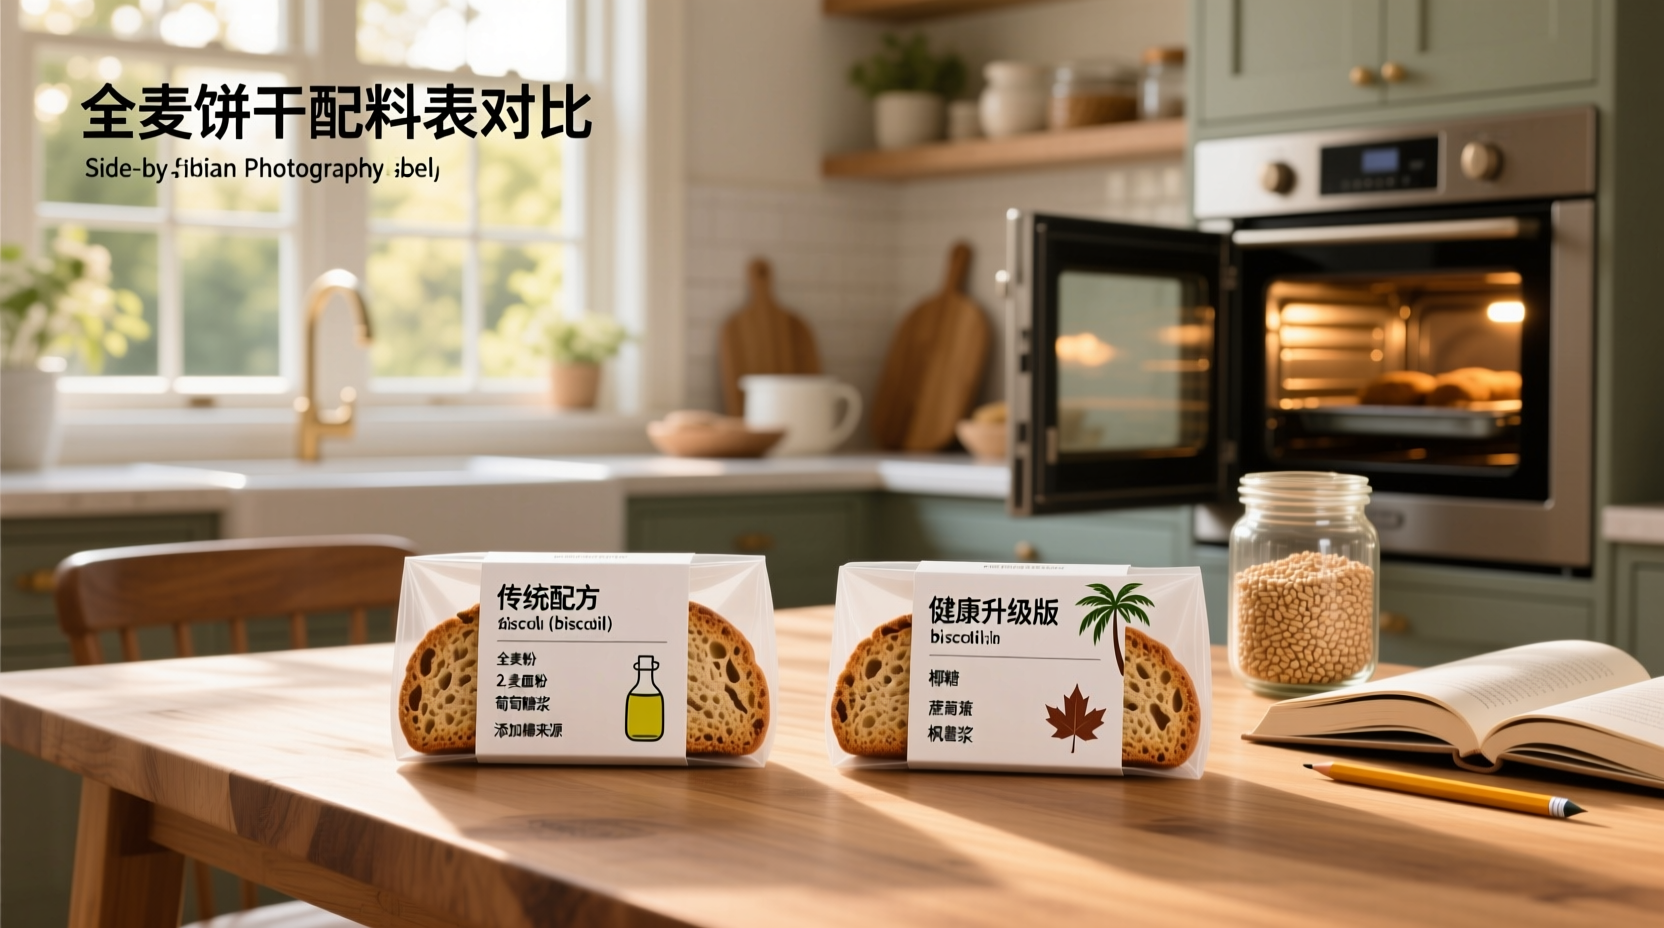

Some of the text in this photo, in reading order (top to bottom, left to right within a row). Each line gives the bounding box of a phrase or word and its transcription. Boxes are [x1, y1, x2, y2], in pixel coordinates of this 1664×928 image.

[496, 583, 600, 612] 传统配方
[928, 595, 1059, 627] 健康升级版
